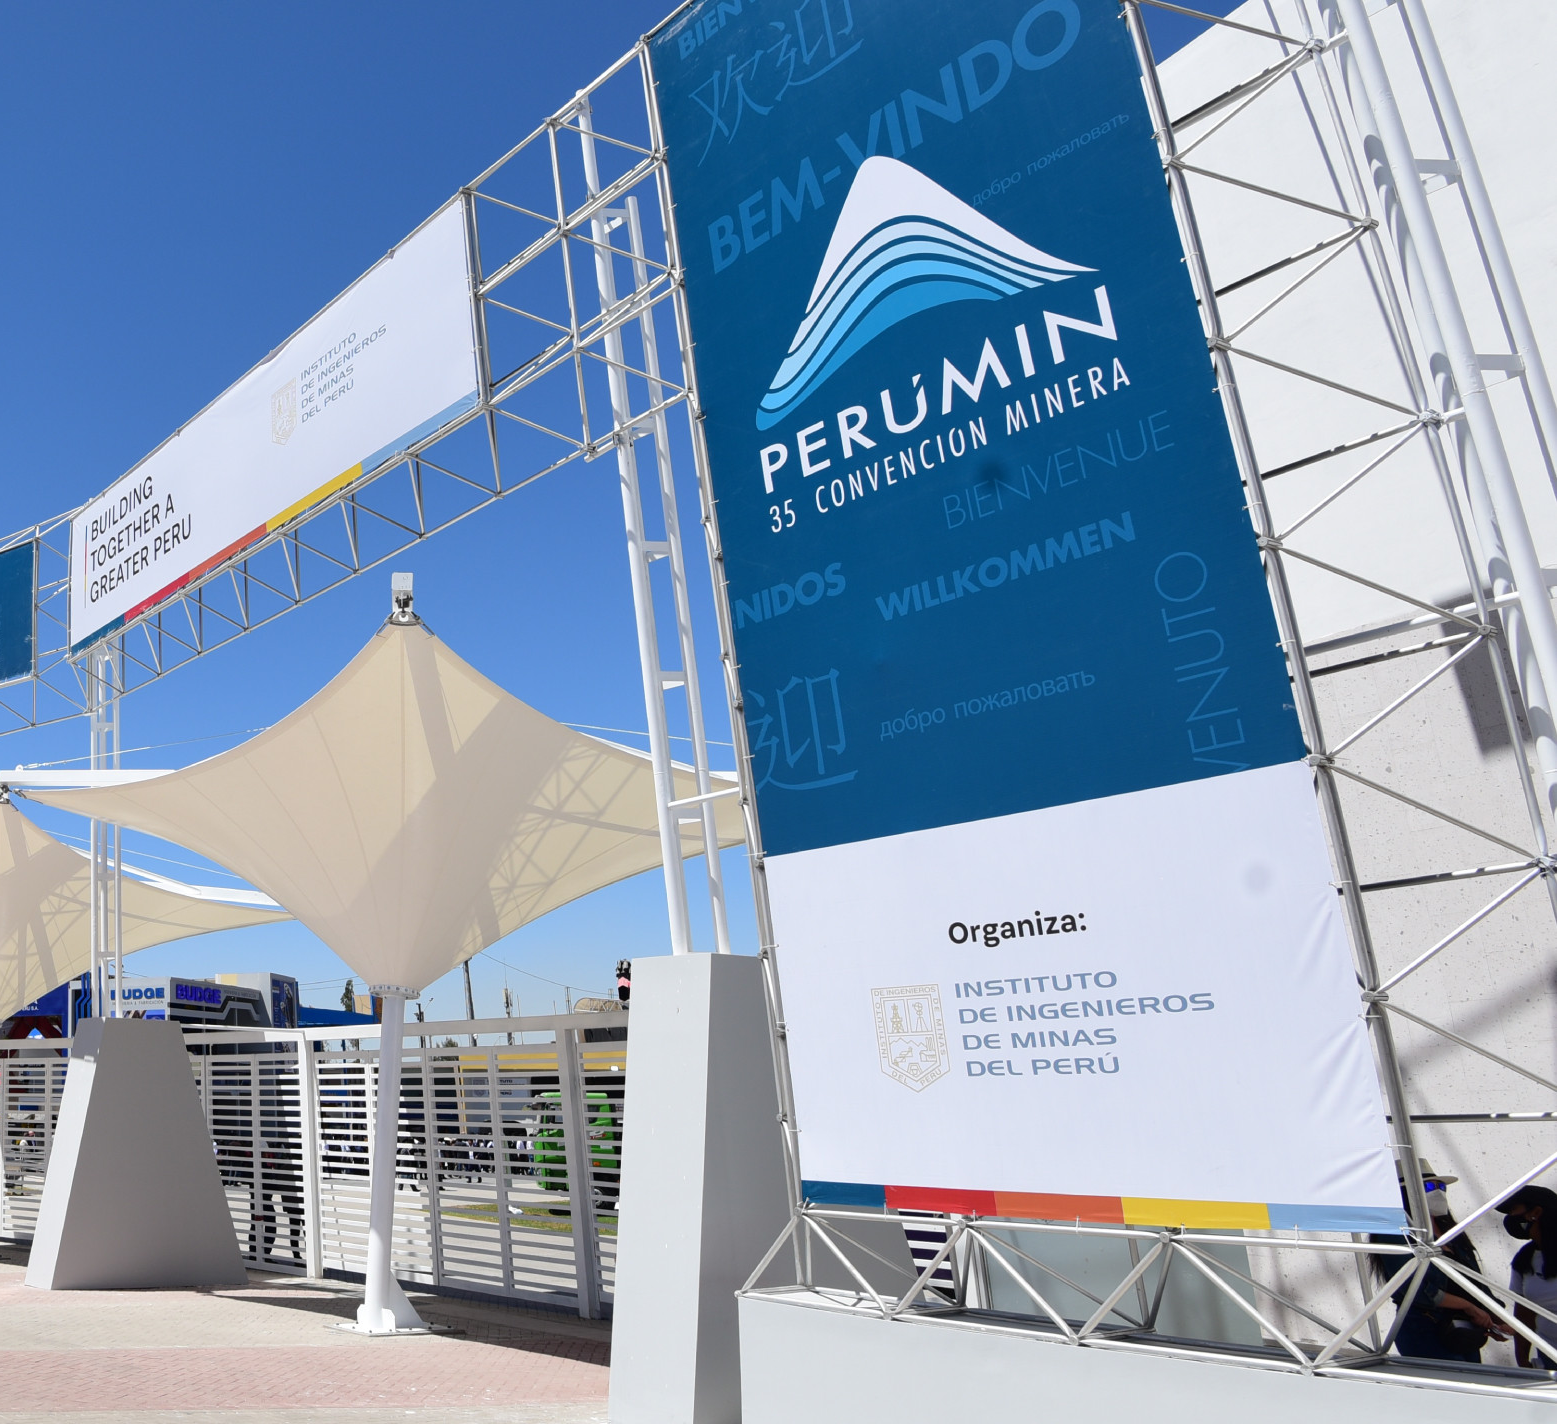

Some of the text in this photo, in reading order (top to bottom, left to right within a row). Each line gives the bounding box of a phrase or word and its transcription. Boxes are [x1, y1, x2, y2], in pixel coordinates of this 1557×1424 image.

[677, 0, 755, 60] BIEN
[707, 0, 1081, 275] BEM-VINDO
[973, 112, 1130, 208] добро пожаловать
[301, 332, 357, 380] INSTITUTO
[301, 324, 387, 395] DE INGENIEROS
[301, 364, 354, 408] DE MINAS
[302, 377, 354, 423] DEL PERÚ
[769, 498, 797, 534] 35
[1005, 357, 1131, 436] MINERA
[943, 410, 1175, 530] BIENVENUE
[91, 476, 153, 542] BUILDING
[91, 494, 175, 572] TOGETHER A
[90, 514, 191, 602] GREATER PERU
[875, 511, 1136, 621] WILLKOMMEN
[731, 562, 846, 631] NIDOS
[880, 670, 1096, 741] добро пожаловать
[947, 910, 1087, 948] Organiza:
[175, 984, 221, 1004] BUDGE
[886, 986, 937, 996] INGENIEROS
[955, 970, 1118, 999] INSTITUTO
[958, 992, 1215, 1025] DE INGENIEROS
[962, 1028, 1118, 1051] DE MINAS
[965, 1052, 1121, 1077] DEL PERÚ
